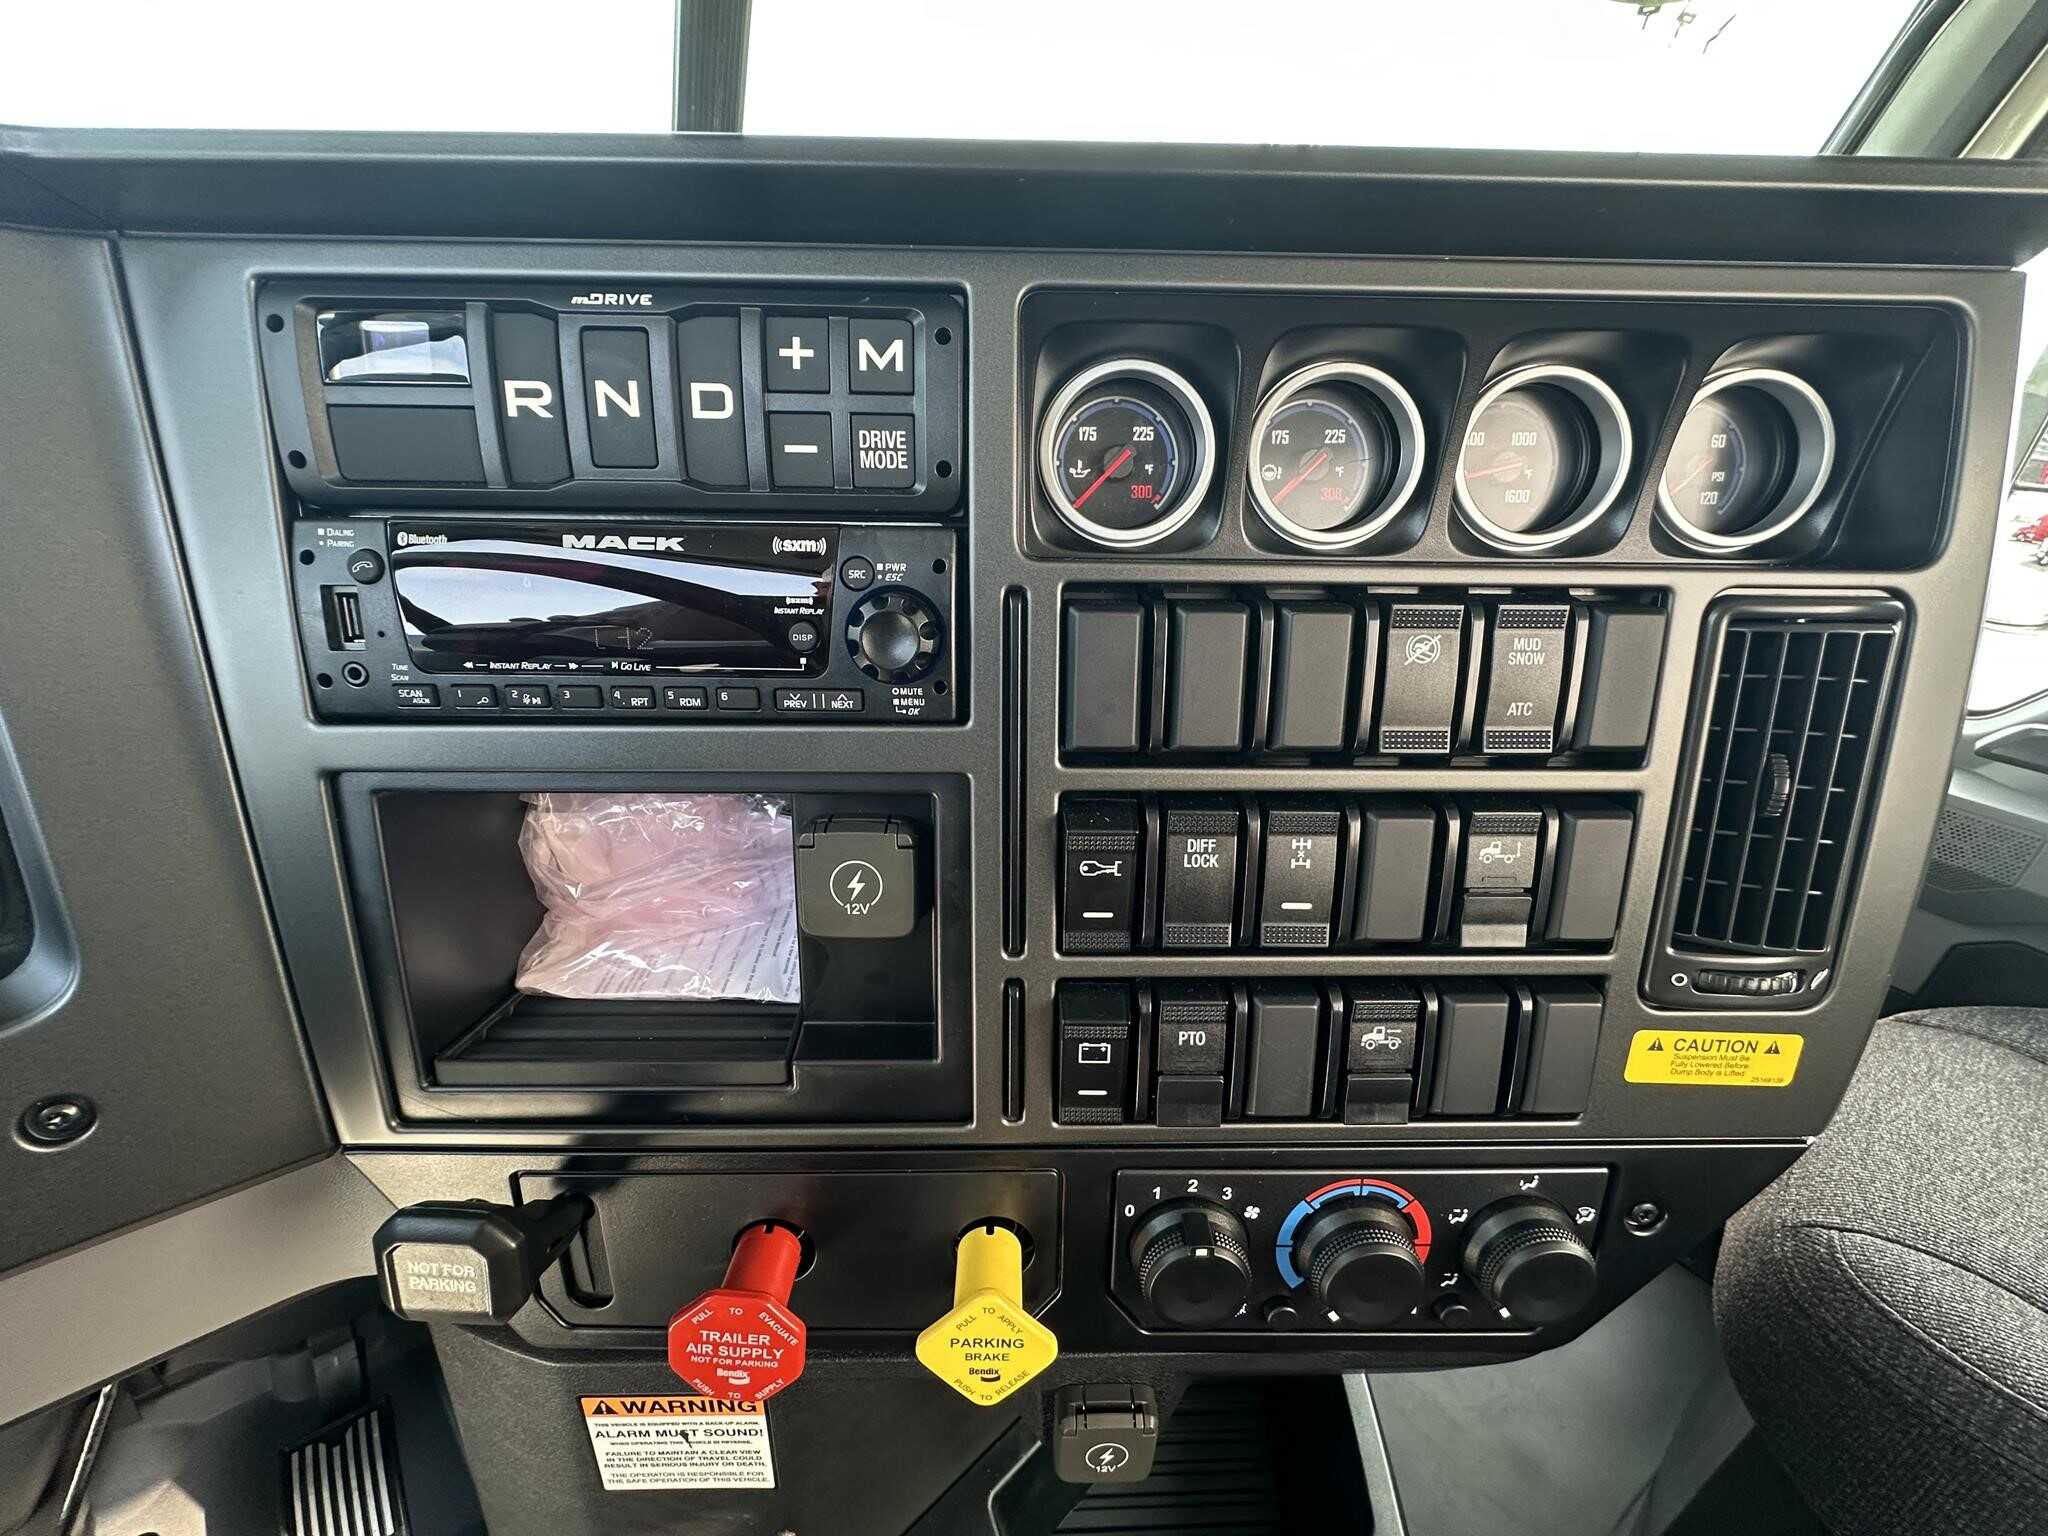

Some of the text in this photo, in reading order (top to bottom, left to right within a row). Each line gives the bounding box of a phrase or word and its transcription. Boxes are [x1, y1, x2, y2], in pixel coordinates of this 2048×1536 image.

[571, 293, 653, 306] mDRIVE
[859, 338, 904, 372] M
[506, 380, 554, 418] R
[594, 381, 641, 418] N
[691, 382, 735, 420] D
[858, 430, 907, 450] DRIVE
[1079, 427, 1097, 441] 175
[1133, 427, 1154, 441] 225
[1271, 430, 1290, 444] 175
[1324, 429, 1346, 443] 225
[1466, 432, 1485, 446] 00
[1511, 432, 1537, 446] 1000
[1711, 434, 1727, 448] 60
[860, 450, 908, 470] MODE
[1711, 472, 1725, 482] PSI
[1130, 485, 1153, 499] 300
[1505, 489, 1531, 503] 1600
[1700, 491, 1718, 505] 120
[408, 534, 448, 545] Bluetooth
[562, 534, 685, 551] MACK
[848, 570, 867, 579] SRC
[885, 563, 907, 572] PWR
[885, 573, 904, 581] ESC
[1513, 638, 1542, 651] MUD
[1508, 652, 1546, 665] SNOW
[398, 689, 423, 697] SCAN
[511, 690, 518, 698] 2
[563, 690, 570, 698] 3
[613, 690, 649, 706] 4 RPT
[721, 692, 728, 700] 6
[900, 687, 923, 695] MUTE
[667, 691, 701, 707] 5 RDM
[784, 700, 807, 708] PREV
[831, 700, 854, 709] NEXT
[900, 698, 925, 706] MENU
[1506, 702, 1534, 716] ATC
[1187, 838, 1217, 852] DIFF
[1183, 854, 1219, 868] LOCK
[844, 903, 870, 915] 12V
[1178, 1031, 1206, 1046] PTO
[1673, 1038, 1759, 1054] CAUTION
[1670, 1060, 1749, 1070] Fully Lowered Before
[1670, 1068, 1693, 1076] Dump
[1187, 1179, 1199, 1192] 2
[1152, 1186, 1161, 1200] 1
[1221, 1187, 1232, 1200] 3
[1124, 1204, 1135, 1217] 0
[408, 1262, 476, 1277] NOT FOR
[409, 1277, 477, 1294] PARKING
[691, 1307, 800, 1347] PULL TO EVACUATE
[955, 1307, 1024, 1335] PULL TO APPLY
[699, 1330, 771, 1346] TRAILER
[950, 1338, 1025, 1349] PARKING
[685, 1342, 784, 1360] AIR SUPPLY
[965, 1352, 1011, 1362] BRAKE
[690, 1355, 779, 1368] NOT FOR PARKING
[716, 1367, 750, 1378] Bendix
[968, 1367, 1000, 1376] Bendix
[692, 1377, 785, 1399] PUSH TO SUPPLY
[953, 1378, 976, 1396] PUSH
[994, 1369, 1030, 1396] RELEASE
[619, 1400, 757, 1415] WARNING
[595, 1429, 651, 1439] ALARM
[703, 1428, 763, 1437] SOUND!
[1095, 1465, 1117, 1473] 12V
